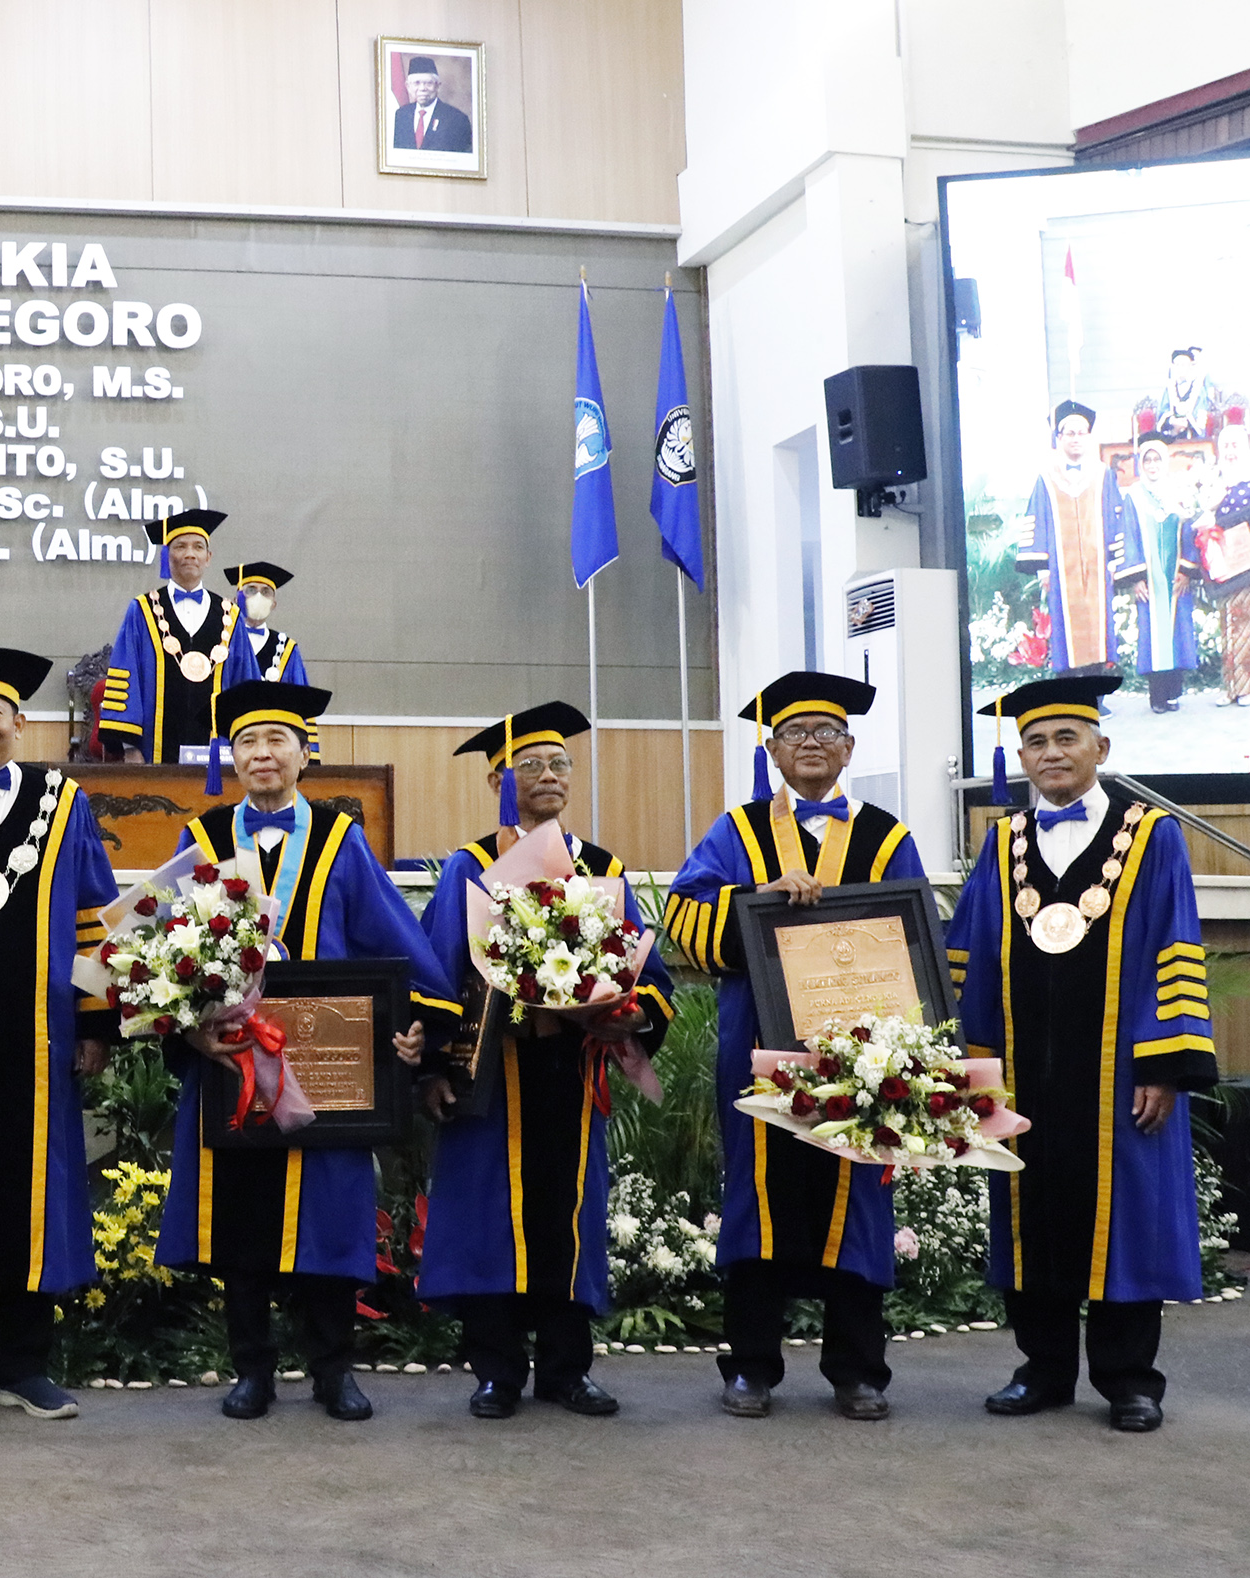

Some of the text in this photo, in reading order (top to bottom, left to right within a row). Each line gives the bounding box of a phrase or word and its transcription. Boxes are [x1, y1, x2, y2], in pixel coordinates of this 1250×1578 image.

[92, 366, 184, 399] M.S.
[99, 447, 185, 479] S.U.
[84, 481, 208, 520] (Alm)
[32, 522, 157, 565] (Alm.)
